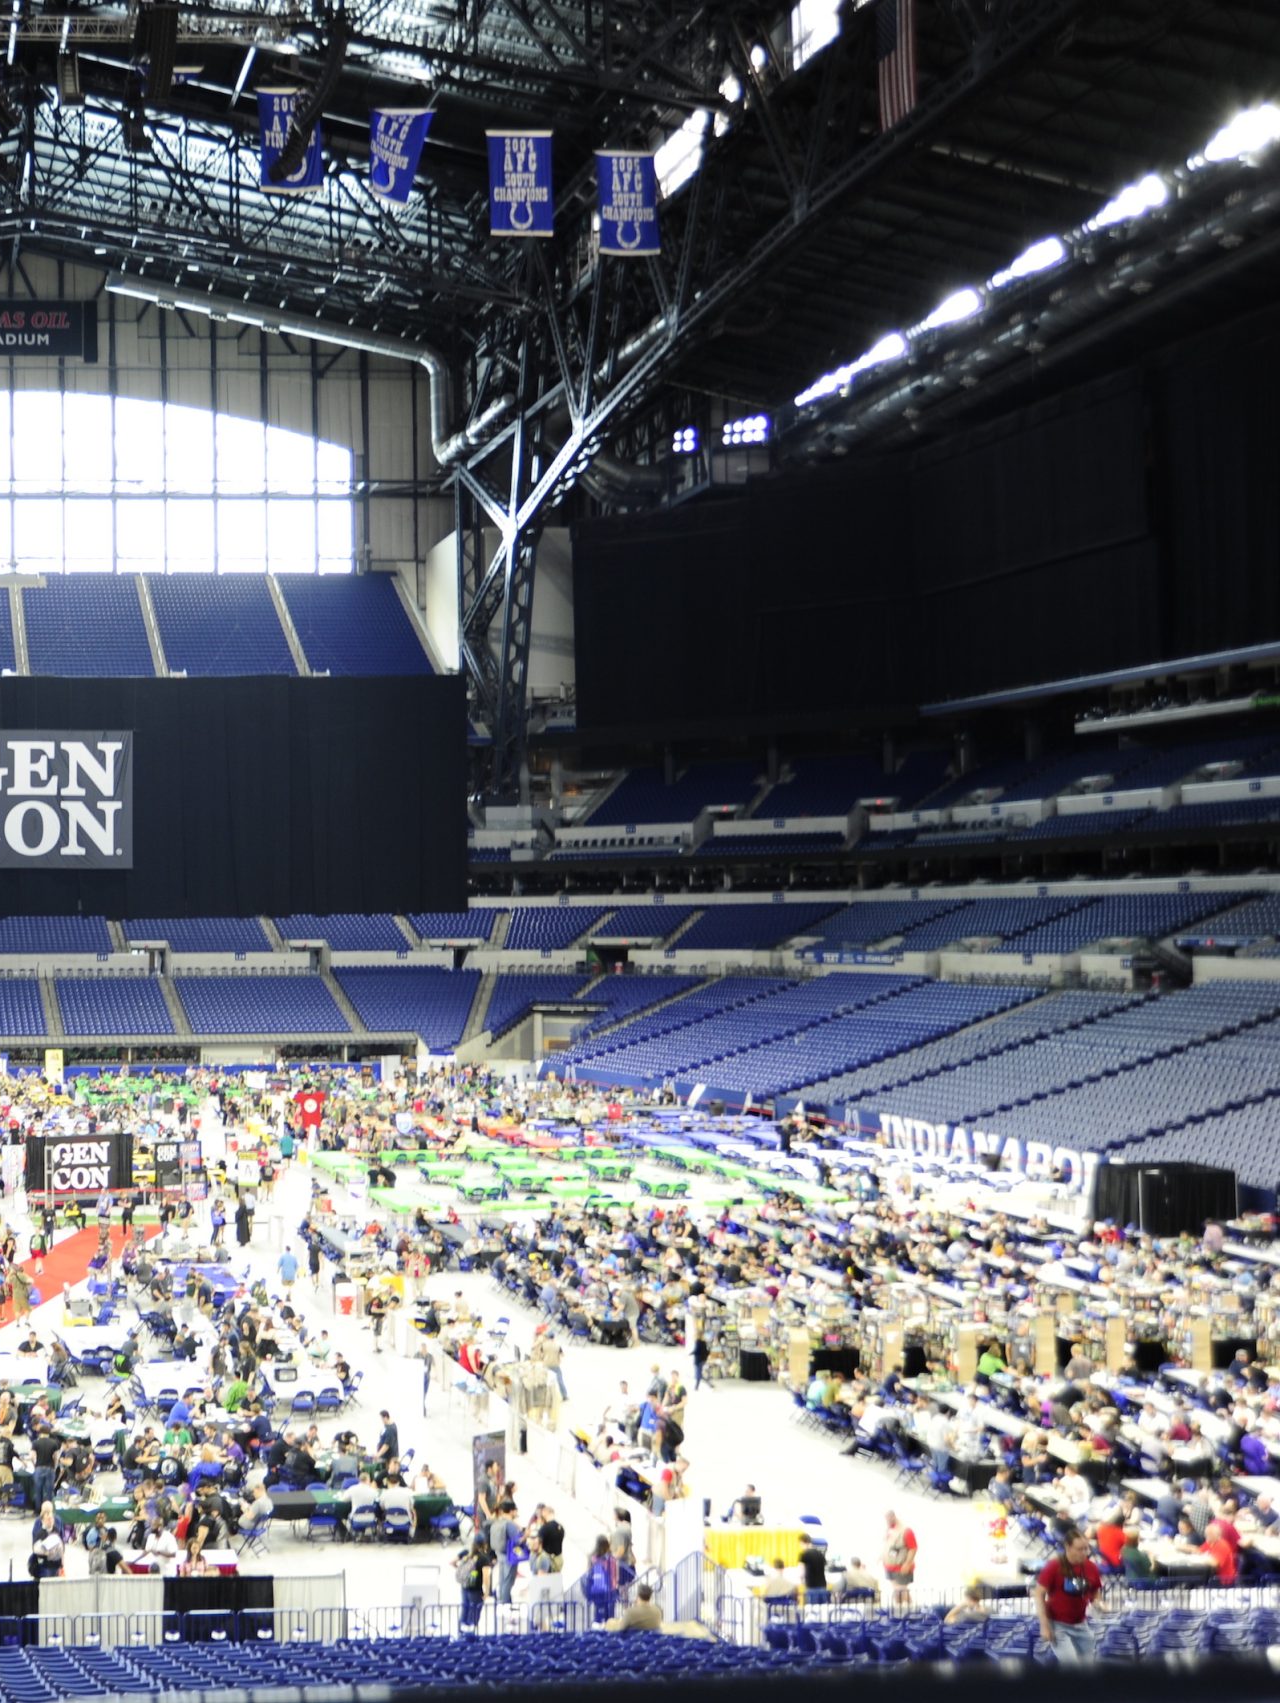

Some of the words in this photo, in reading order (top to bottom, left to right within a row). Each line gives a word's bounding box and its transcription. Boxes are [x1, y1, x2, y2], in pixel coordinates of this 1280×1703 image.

[273, 97, 296, 113] 200
[504, 153, 537, 172] AFC
[505, 173, 535, 186] SOUTH
[611, 173, 642, 191] AFC
[493, 187, 548, 202] CHAMPIONS
[612, 193, 642, 207] SOUTH
[602, 207, 654, 222] CHAMPIONS
[31, 311, 70, 329] OIL
[53, 1141, 110, 1165] GEN
[157, 1145, 177, 1154] GEN
[52, 1166, 111, 1190] CON
